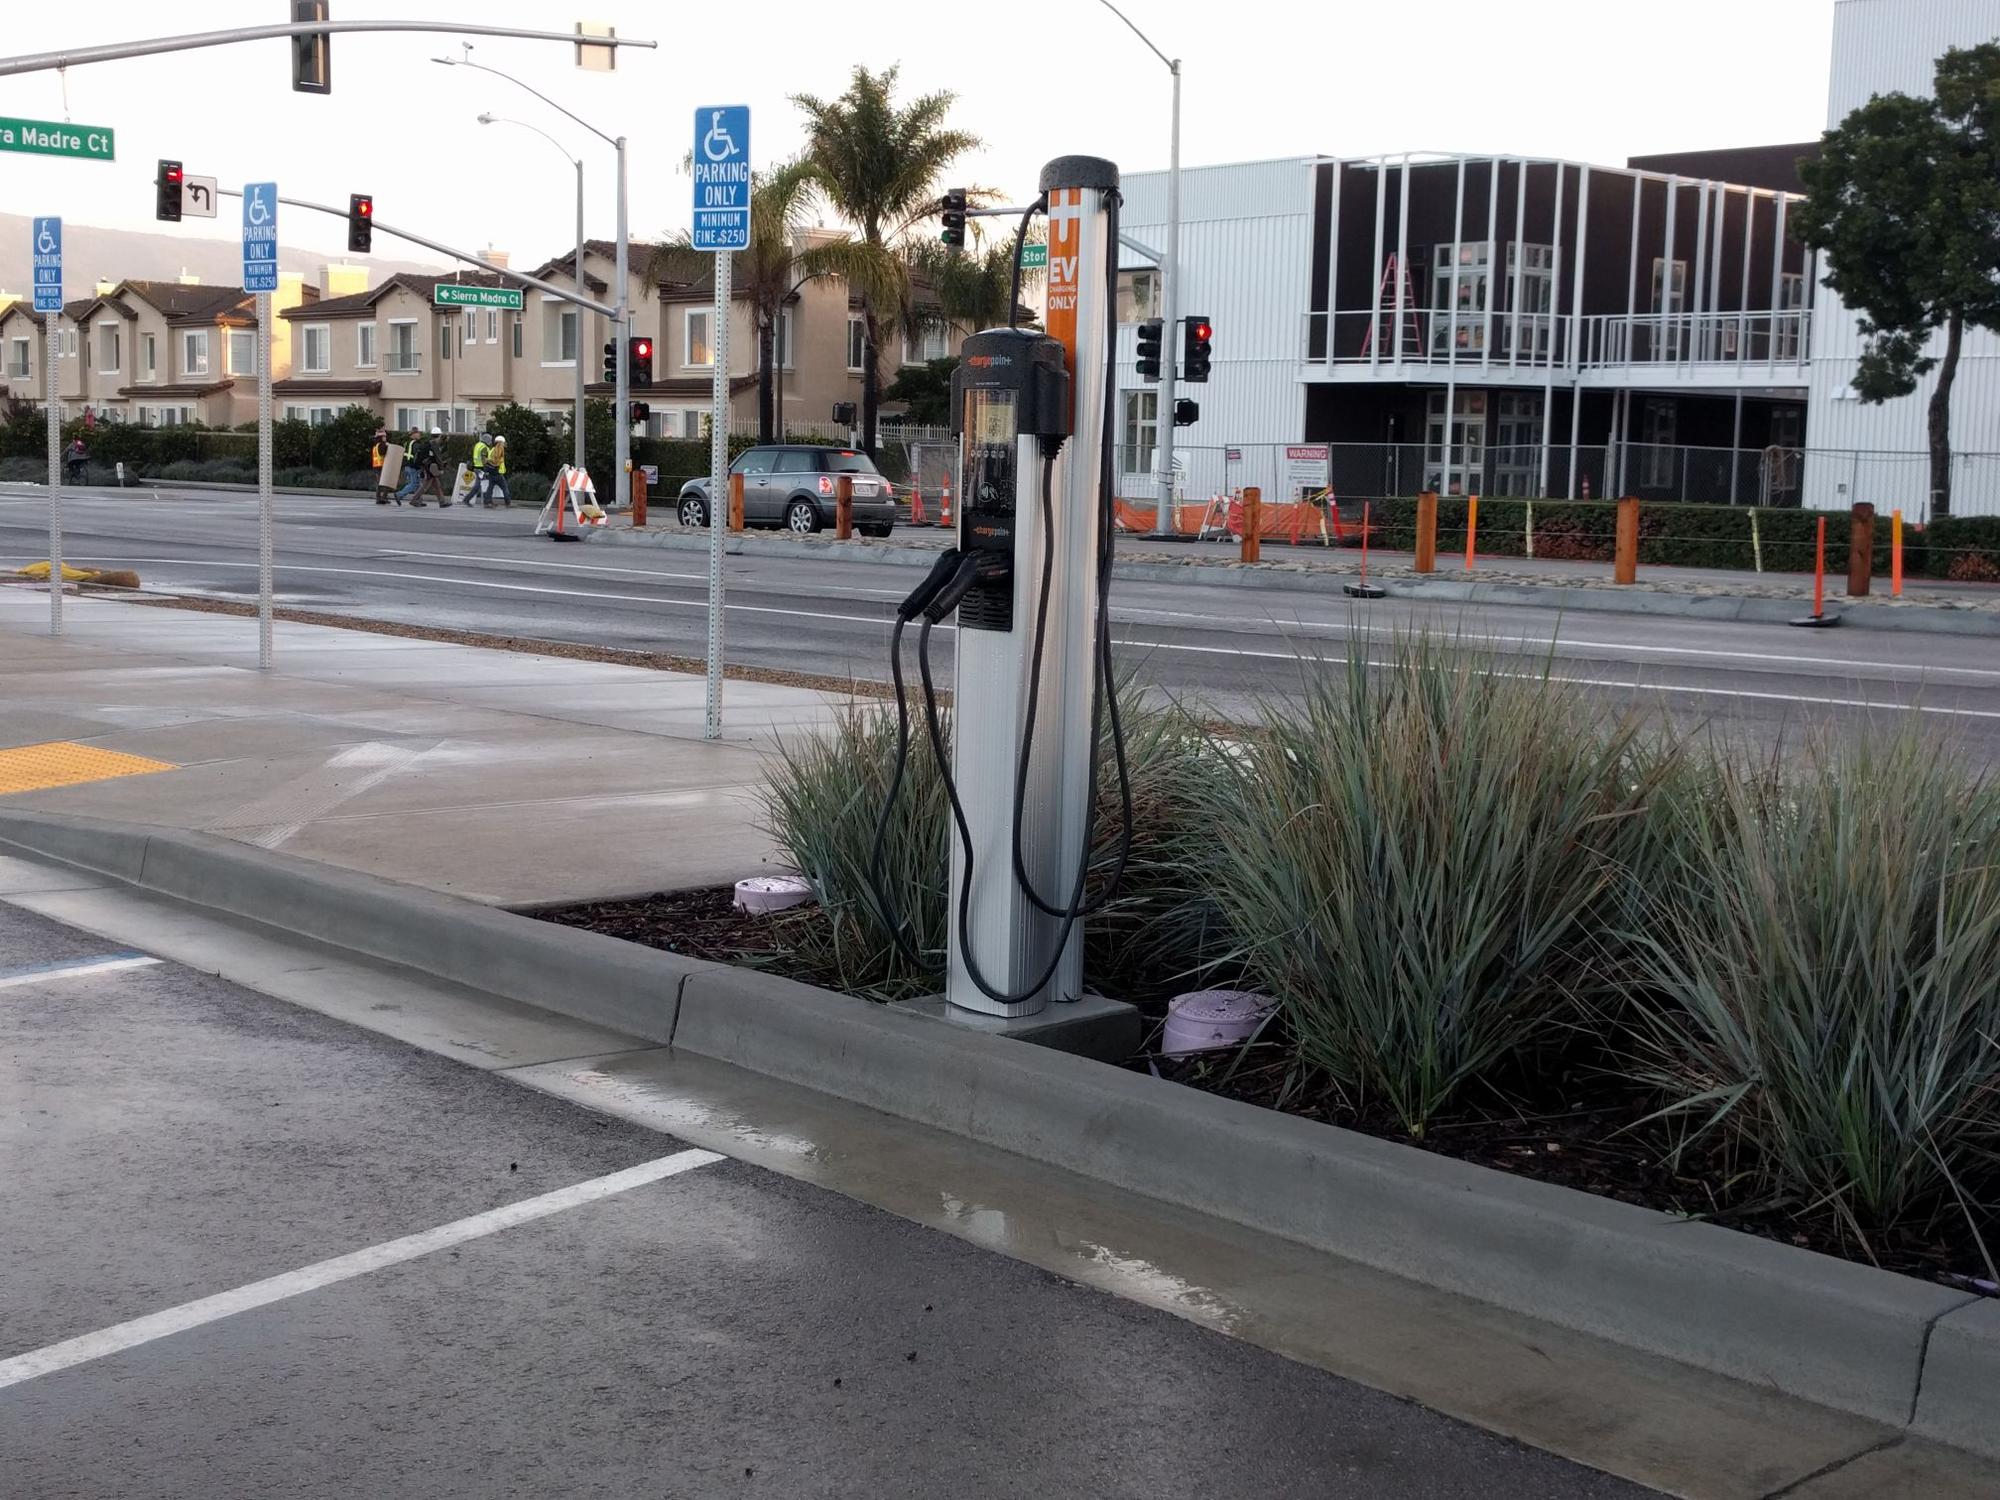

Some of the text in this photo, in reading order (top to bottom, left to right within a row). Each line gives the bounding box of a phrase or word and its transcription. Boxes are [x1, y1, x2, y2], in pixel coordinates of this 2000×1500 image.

[22, 126, 81, 150] Madre
[87, 133, 108, 153] Ct
[695, 162, 748, 184] PARKING
[705, 185, 737, 206] ONLY
[701, 213, 740, 227] MINIMUM
[244, 226, 276, 242] PARKING
[695, 229, 745, 245] FINE $250
[250, 243, 270, 259] ONLY
[1023, 250, 1045, 263] Stor
[34, 254, 61, 268] PARKING
[39, 269, 56, 283] ONLY
[248, 264, 272, 274] MINIMUM
[1050, 256, 1078, 283] EV
[246, 277, 258, 288] FINE
[451, 289, 519, 304] Sierra Madre Ct
[1049, 296, 1076, 310] ONLY
[1289, 449, 1326, 458] WARNING
